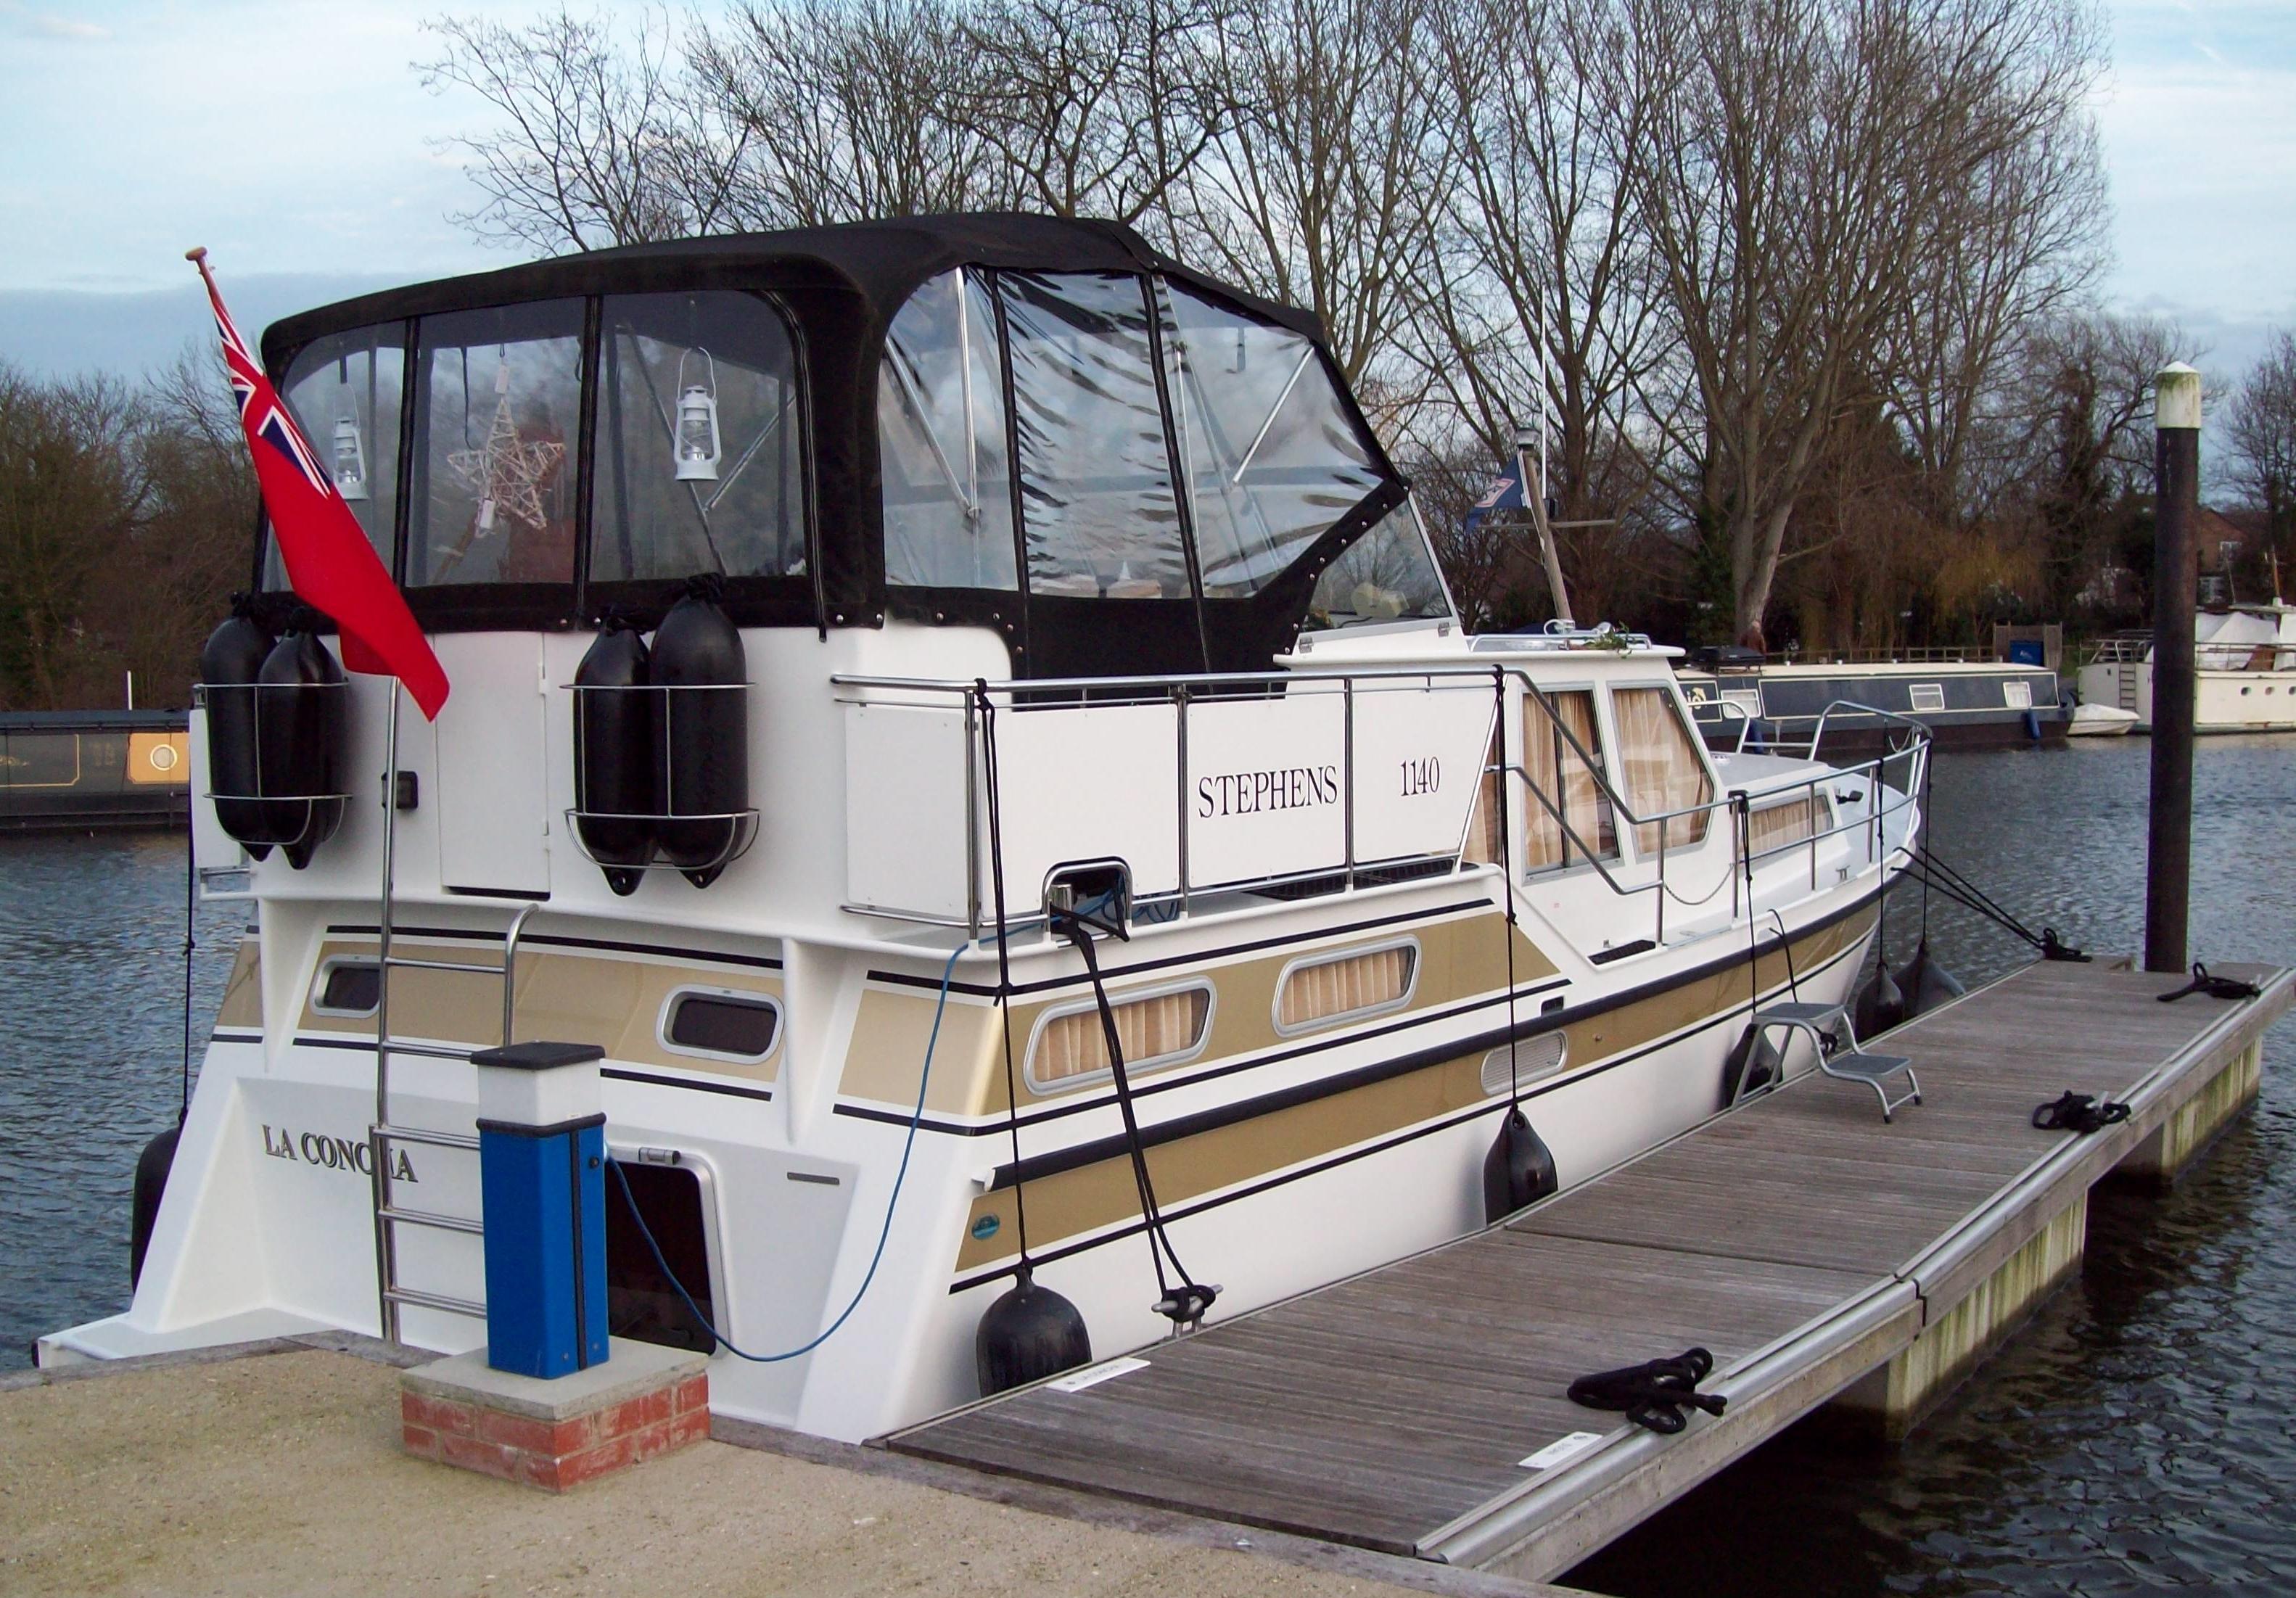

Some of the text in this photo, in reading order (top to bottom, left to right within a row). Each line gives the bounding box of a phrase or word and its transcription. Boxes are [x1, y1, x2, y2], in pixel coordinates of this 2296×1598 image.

[1198, 756, 1441, 818] STEPHENS 1140
[262, 1124, 297, 1161] LA
